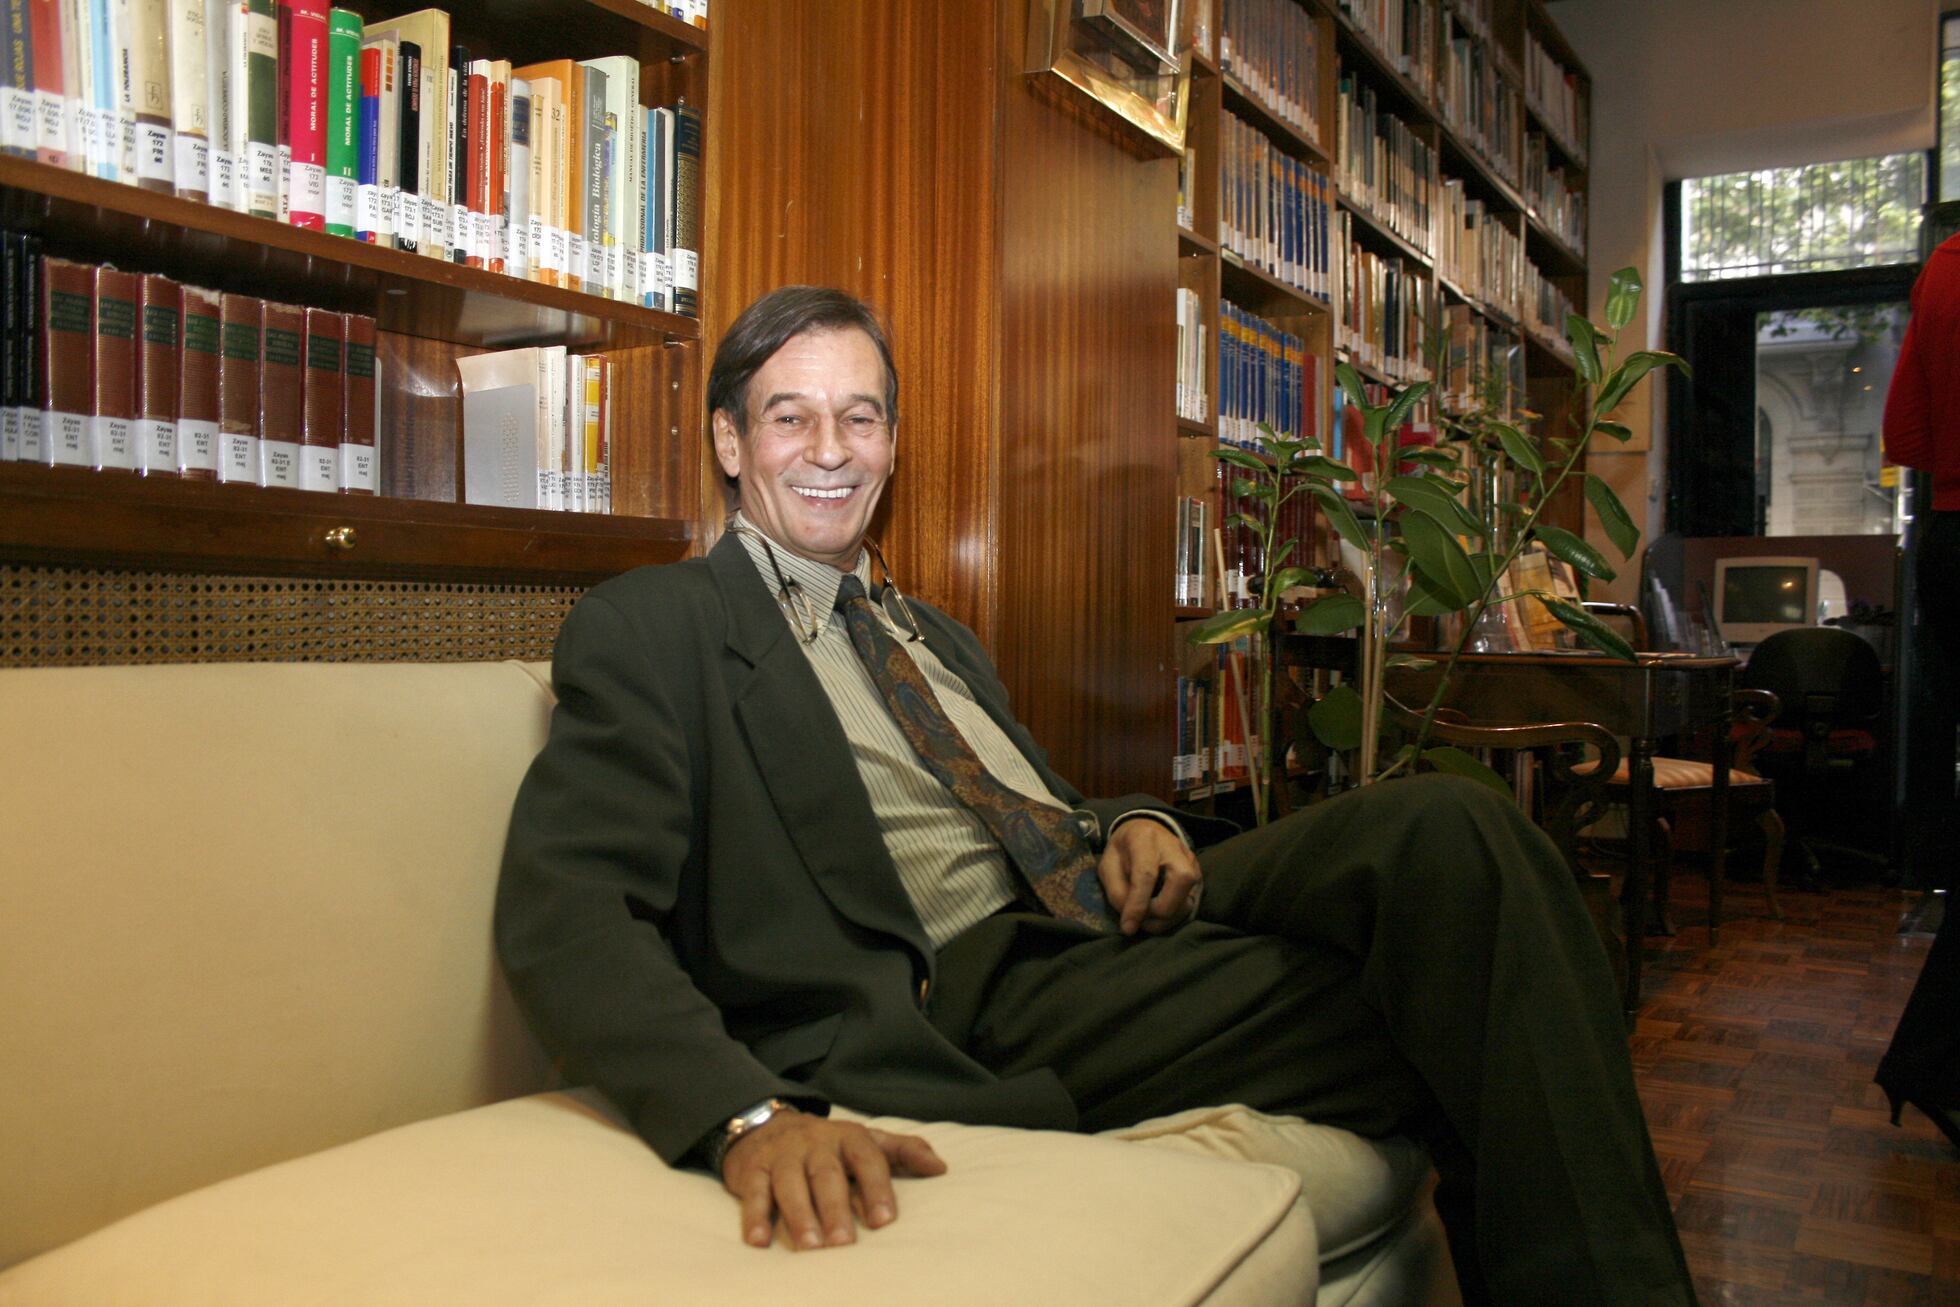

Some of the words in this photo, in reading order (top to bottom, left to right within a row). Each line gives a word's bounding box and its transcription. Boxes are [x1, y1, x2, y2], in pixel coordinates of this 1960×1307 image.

[311, 90, 317, 98] DE
[462, 88, 468, 97] de
[346, 103, 352, 114] DE
[552, 108, 560, 121] 32
[343, 167, 351, 176] II
[592, 142, 601, 198] Biológica
[641, 181, 646, 190] LA
[641, 193, 646, 201] DE
[404, 198, 417, 206] Zayas
